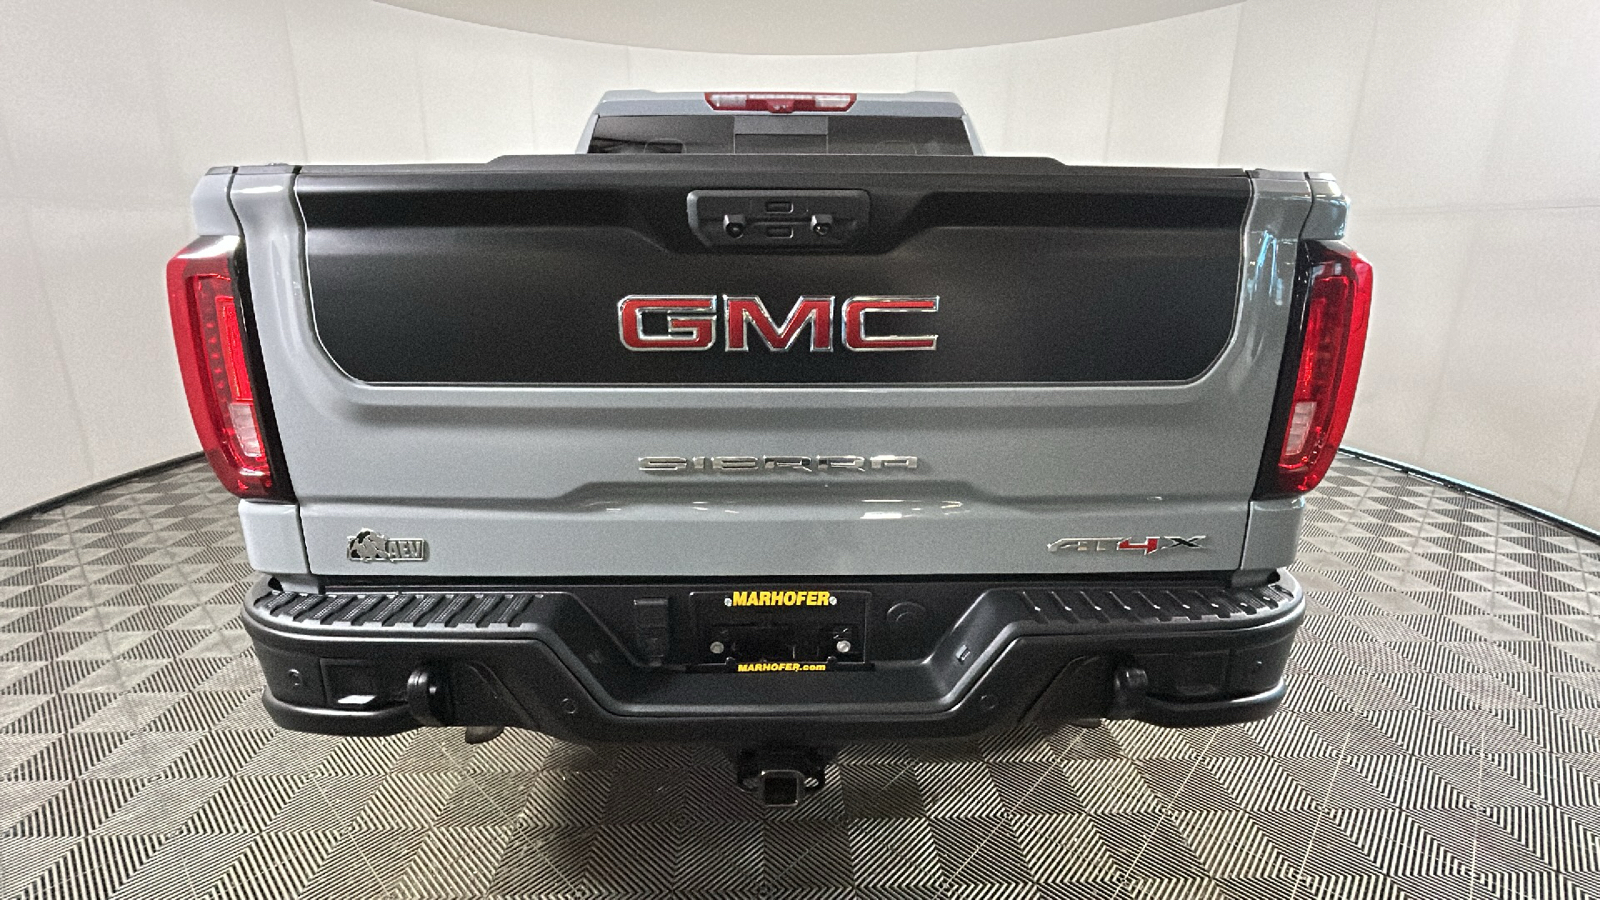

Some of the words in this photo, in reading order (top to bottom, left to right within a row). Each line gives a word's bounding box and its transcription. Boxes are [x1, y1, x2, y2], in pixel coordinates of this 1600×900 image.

[617, 294, 940, 352] GMC
[638, 455, 919, 472] SIERRA
[387, 540, 422, 558] AEV
[732, 591, 830, 606] MARHOFER
[737, 662, 826, 673] MARHOFER.com
